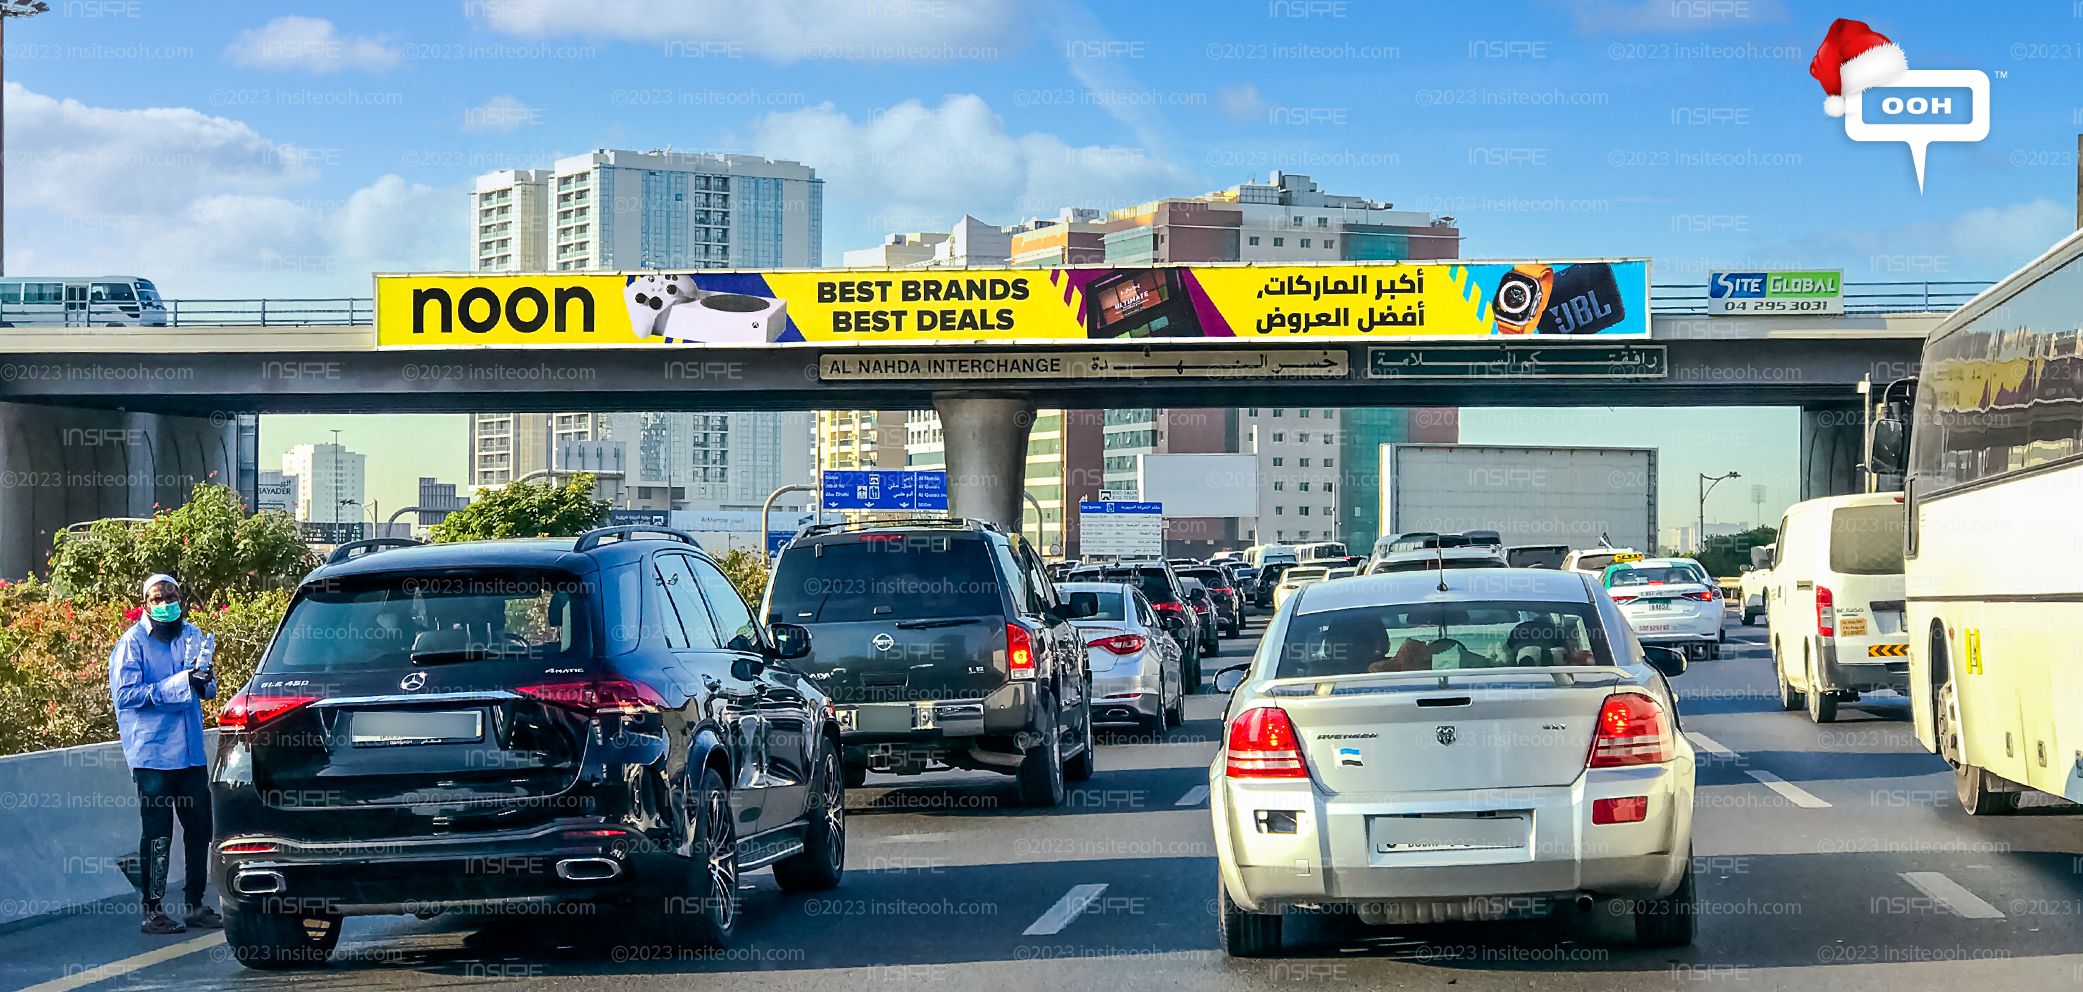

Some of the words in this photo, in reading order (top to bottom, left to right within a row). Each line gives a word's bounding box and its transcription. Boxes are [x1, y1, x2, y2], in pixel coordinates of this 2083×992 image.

[817, 280, 893, 303] BEST
[901, 278, 1030, 302] BRANDS
[1375, 268, 1425, 299] أكبر
[1711, 272, 1762, 297] SITE
[1769, 276, 1836, 294] GLOBAL
[412, 286, 595, 334] noon
[1113, 290, 1149, 310] ULTIMATE
[1558, 290, 1612, 333] JBL
[1725, 301, 1747, 311] 04
[1754, 301, 1787, 311] 295
[1789, 300, 1828, 311] 3031
[832, 310, 908, 333] BEST
[916, 308, 1015, 332] DEALS
[1255, 306, 1351, 335] العروض
[1357, 301, 1425, 327] أفضل
[829, 360, 853, 374] AL
[858, 360, 921, 374] NAHDA
[927, 358, 1061, 373] INTERCHANGE
